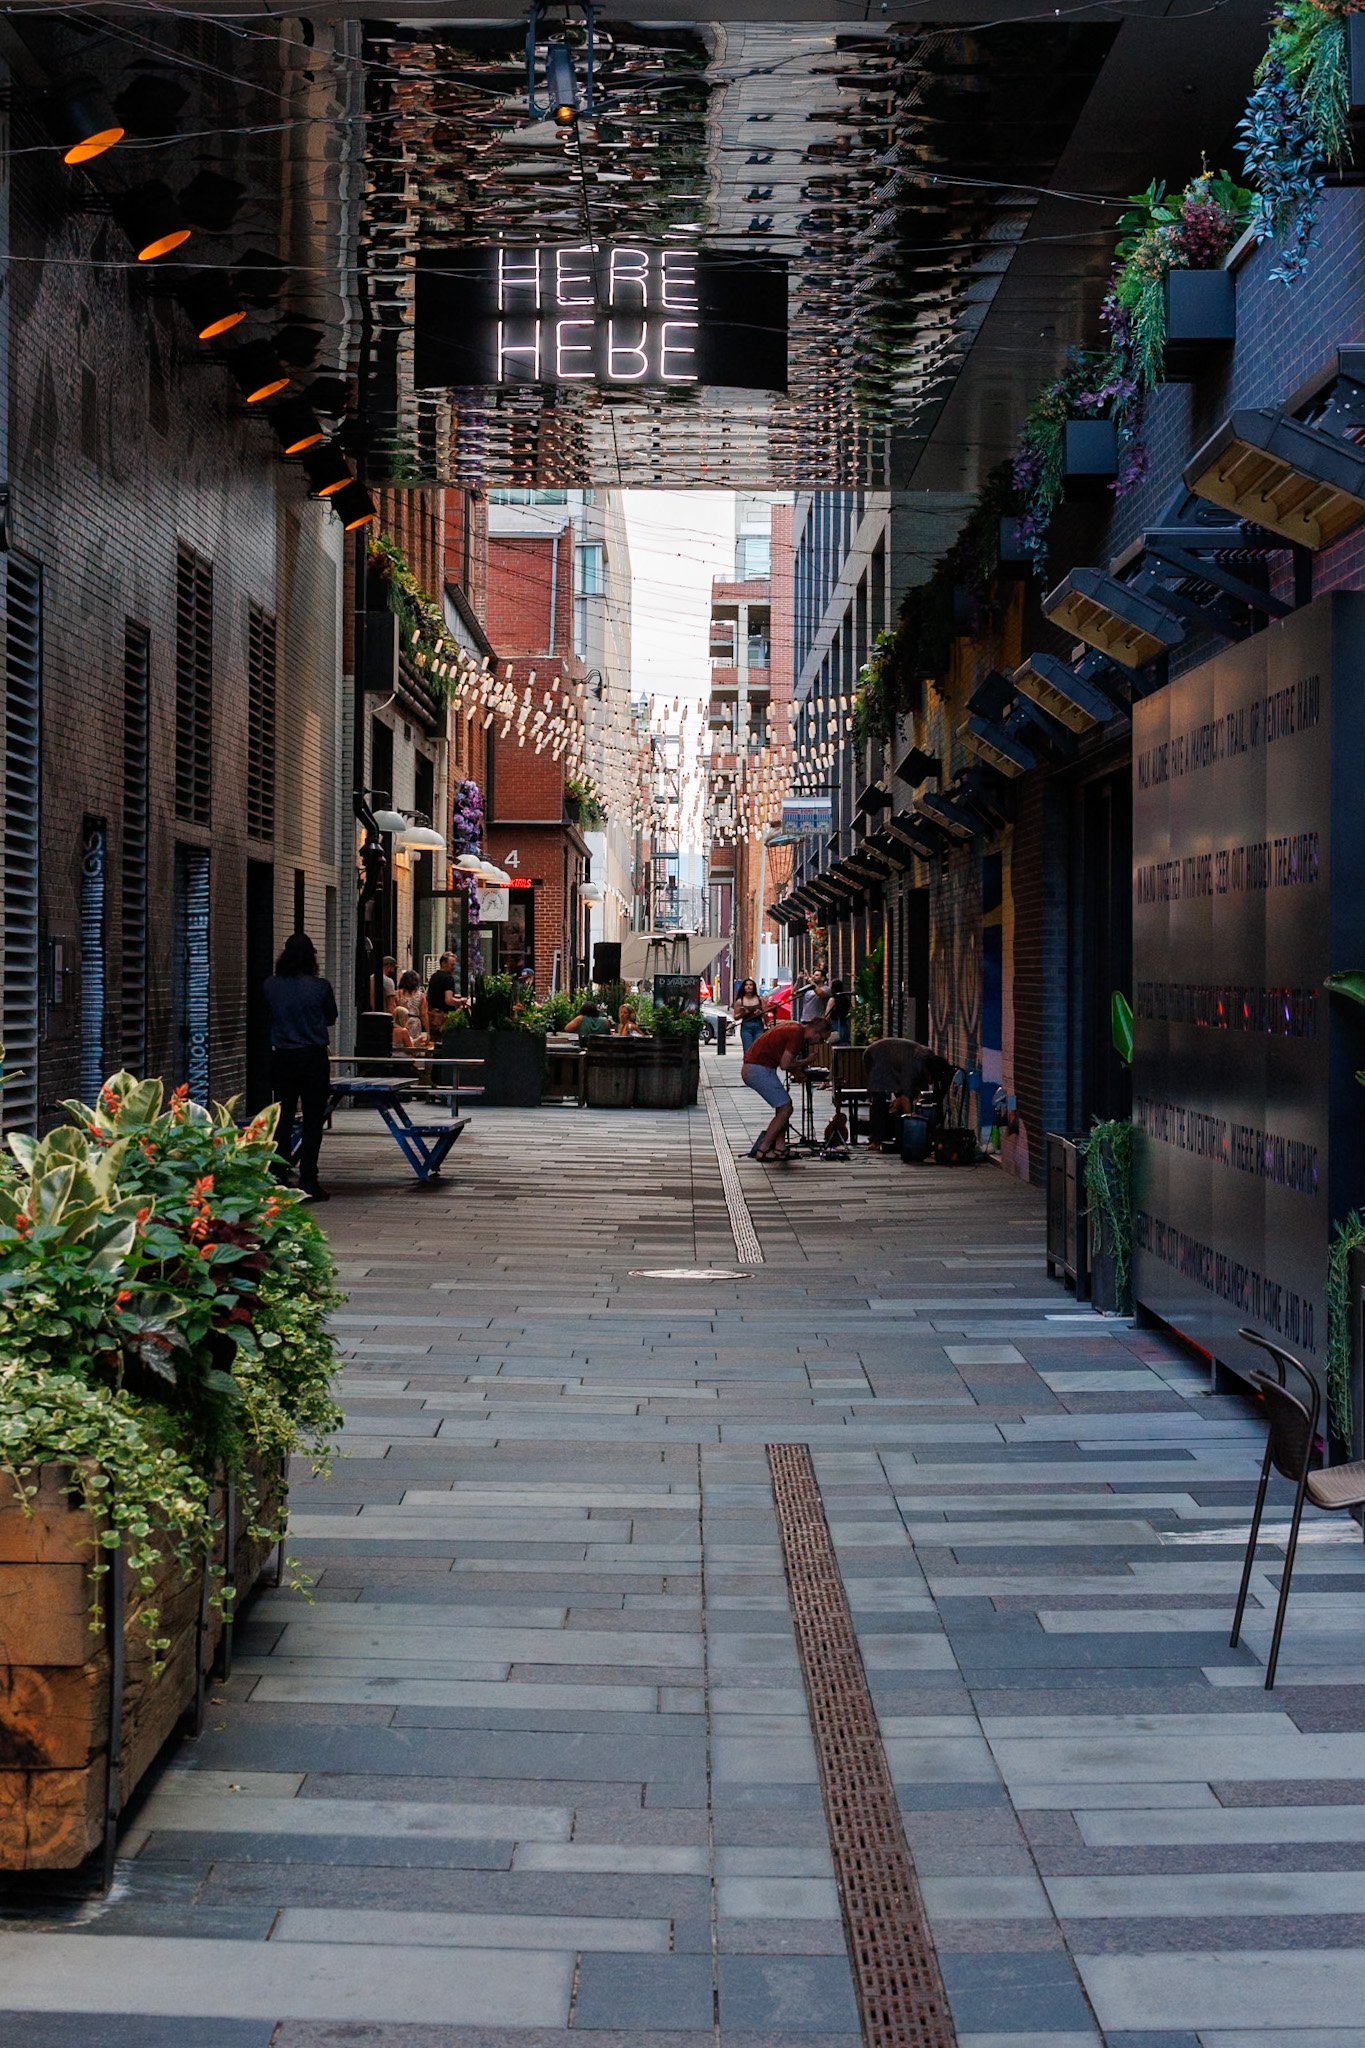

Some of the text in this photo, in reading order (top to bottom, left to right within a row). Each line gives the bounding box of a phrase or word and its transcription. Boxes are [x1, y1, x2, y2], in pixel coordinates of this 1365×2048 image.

[498, 248, 699, 311] HERE
[1263, 685, 1296, 743] VENTURE
[1298, 675, 1320, 732] HAND
[504, 850, 520, 869] 4
[1216, 849, 1229, 894] SEEK
[1232, 847, 1244, 892] OUT
[1246, 841, 1272, 892] HIDDEN
[1274, 832, 1319, 888] TREASURES
[1231, 1122, 1254, 1174] WHERE
[1256, 1130, 1285, 1184] PASSION
[1252, 1271, 1261, 1320] TO
[1263, 1277, 1282, 1333] COME
[1284, 1289, 1300, 1345] AND
